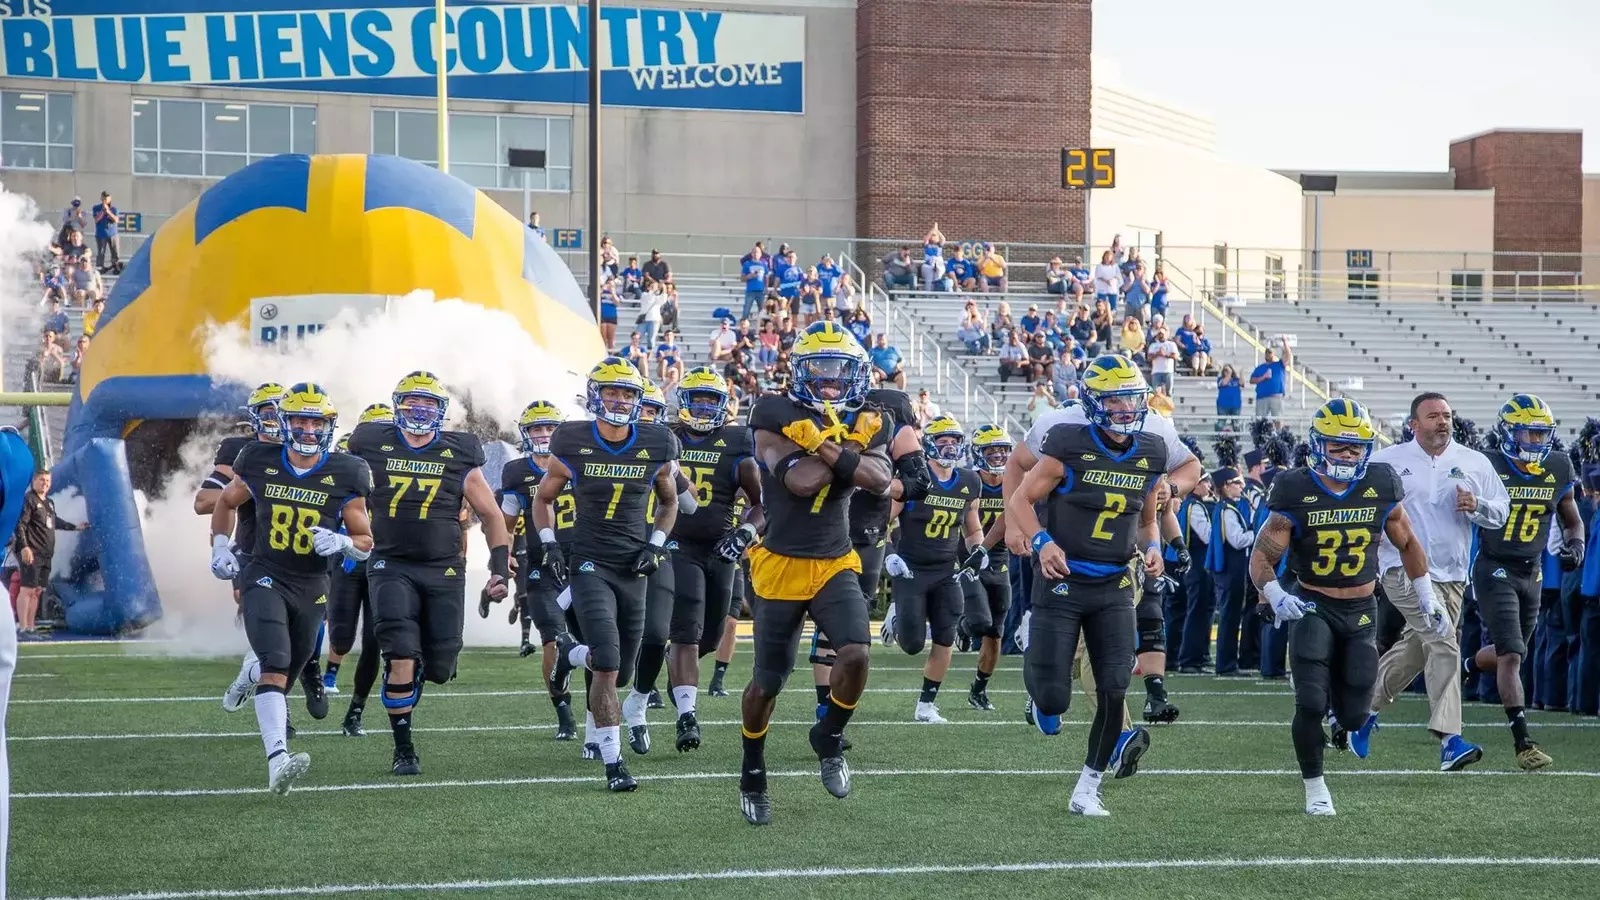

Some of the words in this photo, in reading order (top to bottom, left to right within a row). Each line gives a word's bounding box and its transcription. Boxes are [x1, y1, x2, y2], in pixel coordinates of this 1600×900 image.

[2, 16, 191, 82] BLUE
[205, 9, 395, 80] HENS
[411, 6, 722, 75] COUNTRY
[628, 62, 783, 90] WELCOME
[1066, 150, 1113, 186] 25
[558, 230, 578, 246] FF
[962, 242, 984, 258] GG
[1349, 251, 1370, 267] HH
[385, 458, 446, 476] DELAWARE
[680, 450, 721, 464] LAWARE
[584, 463, 647, 479] DELAWARE
[1082, 469, 1147, 490] DELAWARE
[264, 483, 329, 507] DELAWARE
[387, 475, 442, 520] 77
[604, 482, 625, 520] 1
[924, 494, 966, 510] DELAWARE
[1506, 486, 1555, 500] ELAWARE
[1091, 492, 1127, 540] 2
[1307, 507, 1377, 526] DELAWARE
[1503, 504, 1547, 543] 16
[269, 504, 321, 555] 88
[1312, 528, 1371, 576] 33
